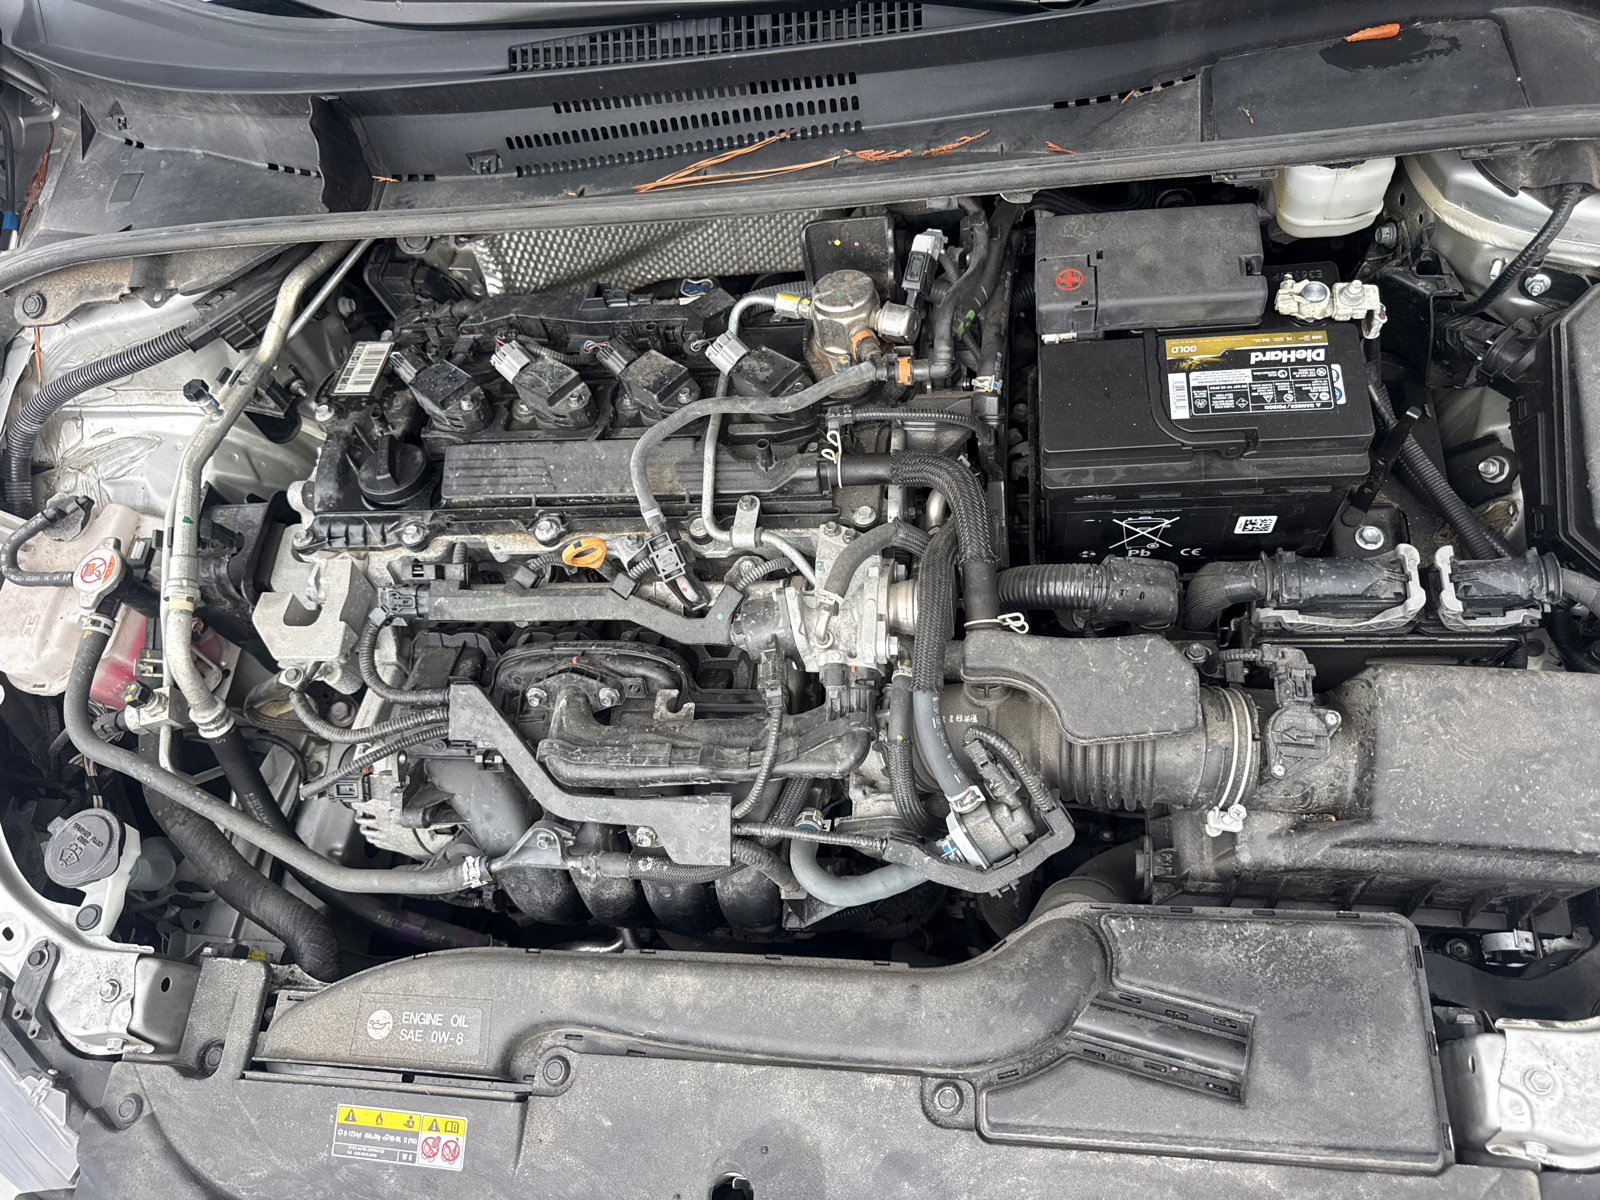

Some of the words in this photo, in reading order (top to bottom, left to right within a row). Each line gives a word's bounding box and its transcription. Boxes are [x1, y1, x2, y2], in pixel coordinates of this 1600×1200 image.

[1171, 345, 1197, 354] GOLD
[1250, 348, 1326, 365] DieHard
[1128, 549, 1151, 557] Pb
[1180, 548, 1202, 556] CE
[402, 1012, 444, 1026] ENGINE
[450, 1014, 469, 1028] OIL
[399, 1029, 423, 1042] SAE
[431, 1030, 464, 1044] 0W-8
